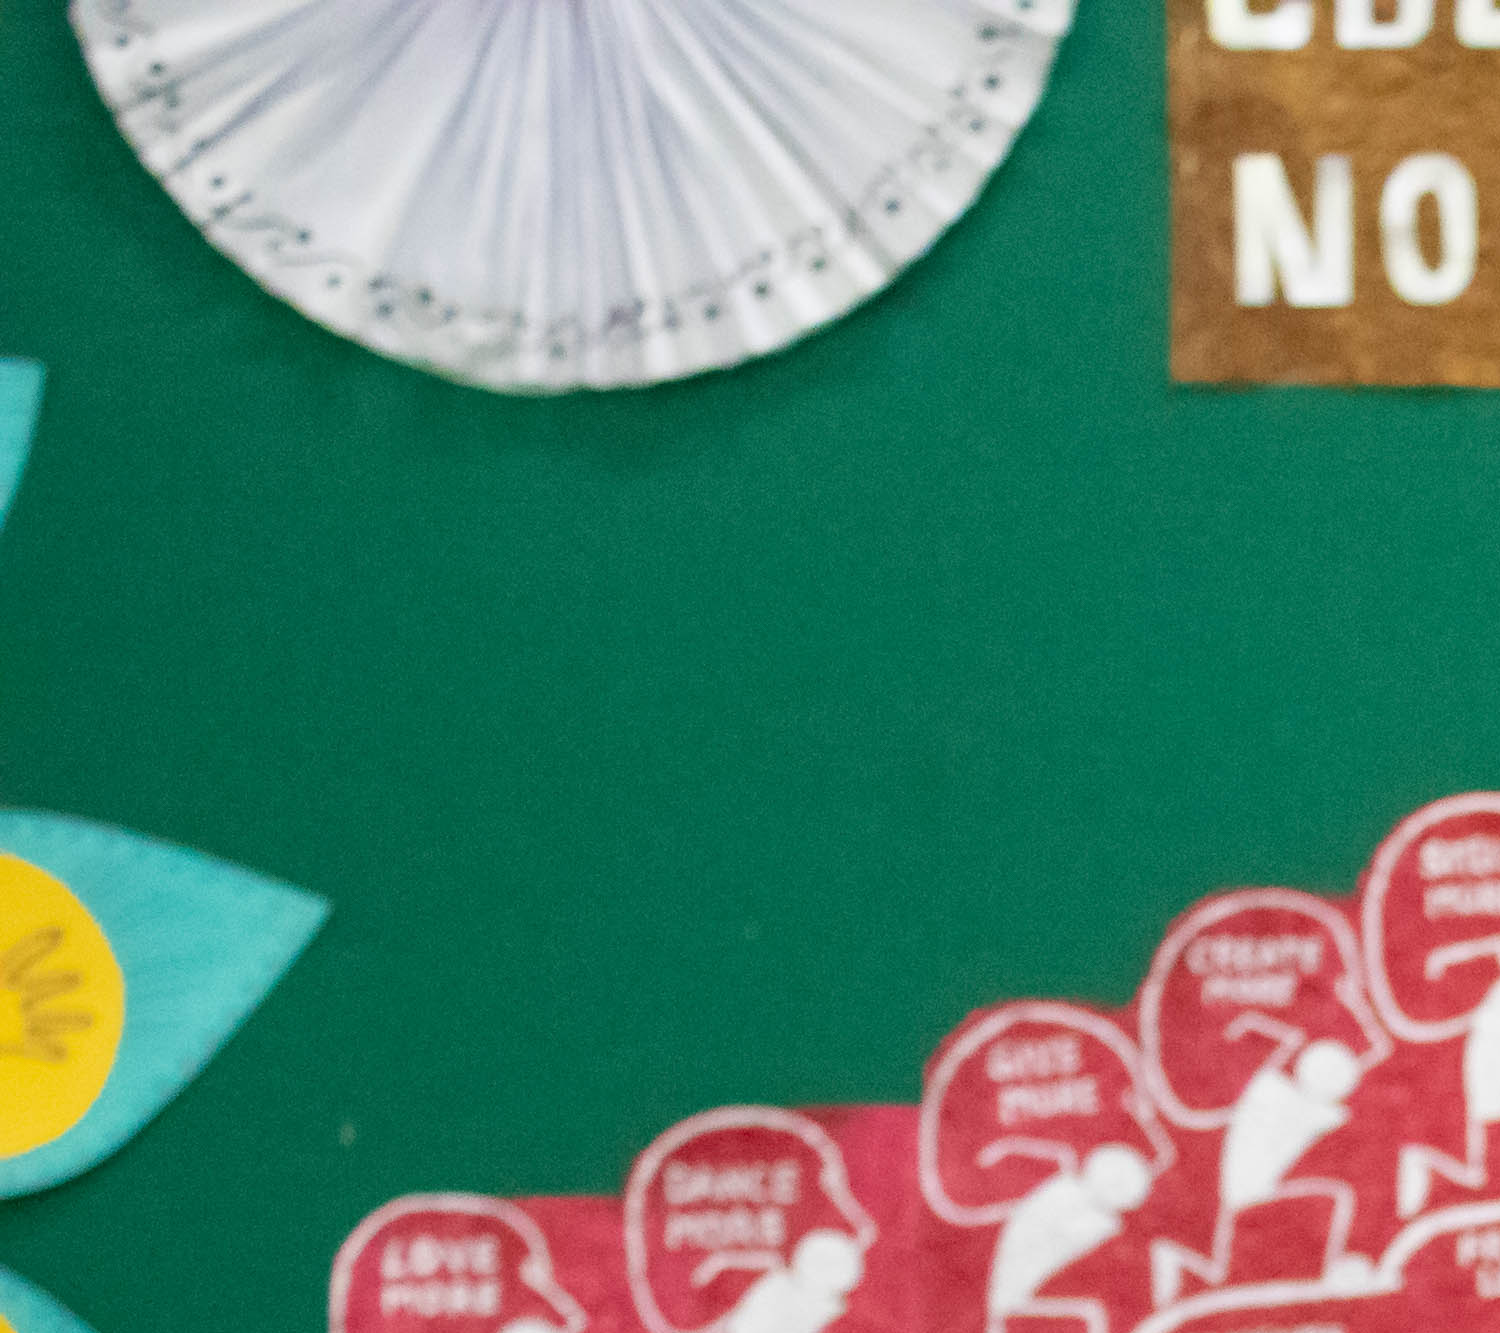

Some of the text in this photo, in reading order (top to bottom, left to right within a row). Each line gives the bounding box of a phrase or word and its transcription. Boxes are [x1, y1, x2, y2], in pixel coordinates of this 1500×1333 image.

[1231, 150, 1480, 309] NO
[999, 1075, 1098, 1125] MORE
[664, 1161, 798, 1203] DANCE
[666, 1208, 785, 1251] MORE
[379, 1233, 501, 1278] LOVE
[379, 1278, 502, 1319] MORE
